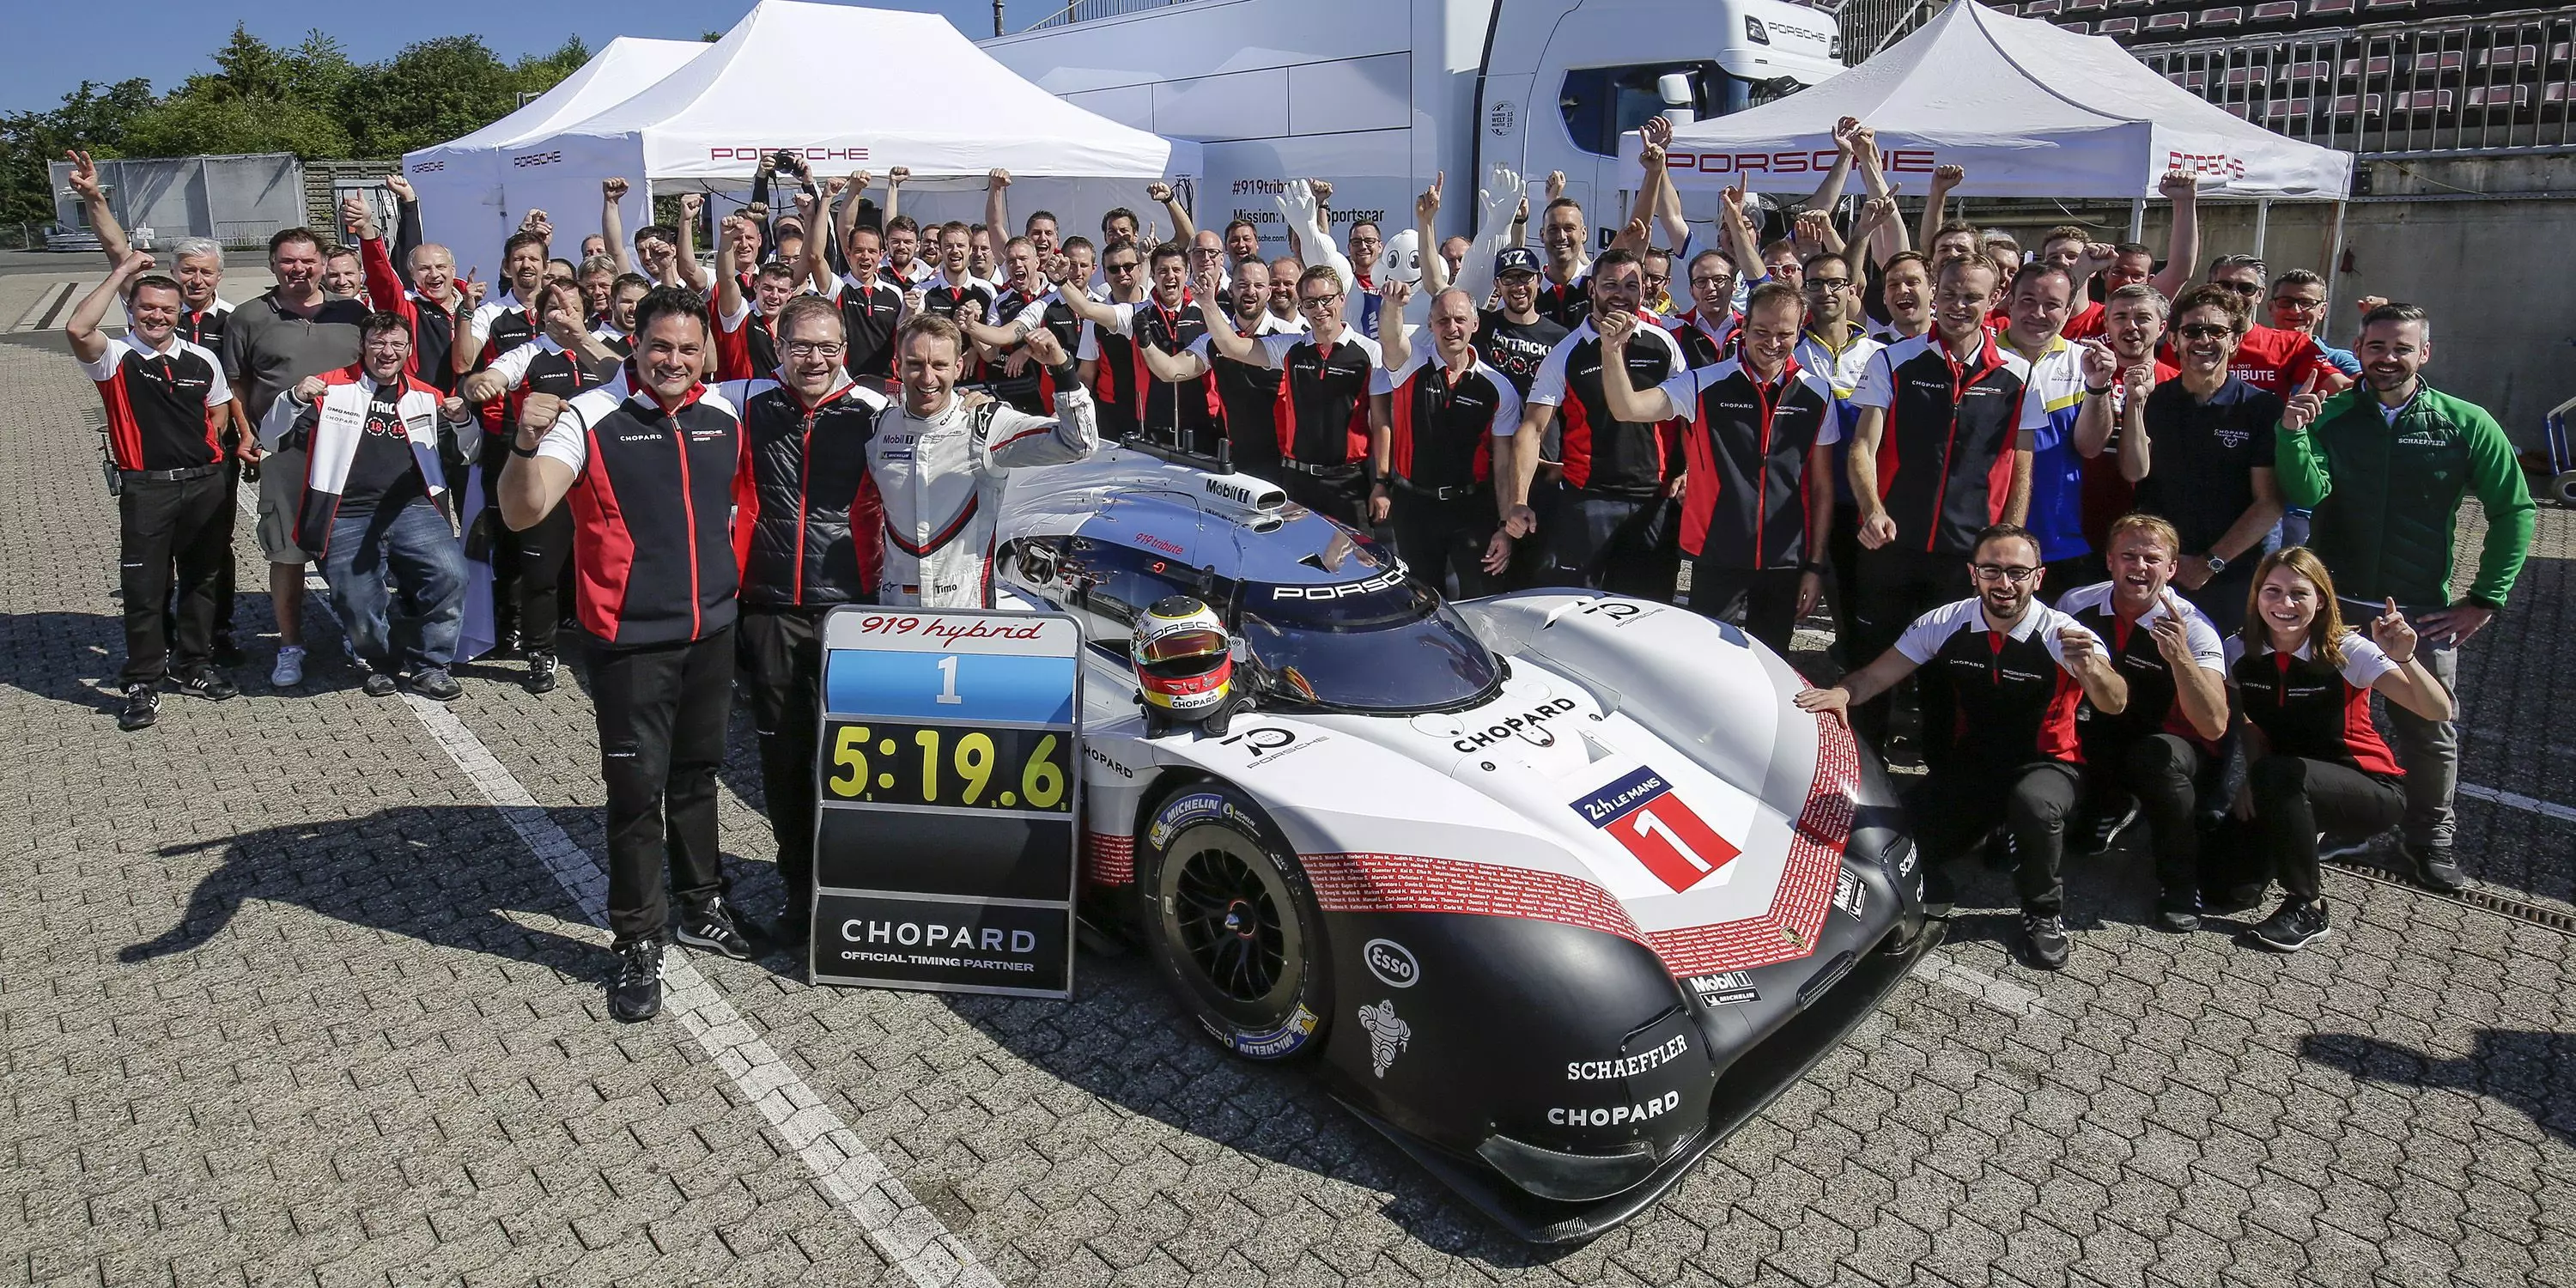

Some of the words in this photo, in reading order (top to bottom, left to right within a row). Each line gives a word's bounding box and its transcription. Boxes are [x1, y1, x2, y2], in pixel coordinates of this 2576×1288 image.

[1769, 21, 1826, 43] PORSCHE
[411, 161, 444, 173] PORSCHE
[513, 151, 561, 168] PORSCHE
[2168, 151, 2245, 179] PORSCHE
[1231, 179, 1289, 195] #919trib
[1233, 209, 1279, 223] Mission:
[325, 414, 358, 425] CHOPARD
[370, 422, 381, 432] 18
[883, 434, 904, 444] Mobil
[2397, 437, 2445, 447] SCHAEFFLER
[1206, 478, 1238, 501] Mobil
[1134, 532, 1154, 544] 919
[1151, 538, 1183, 555] tribute
[935, 583, 957, 594] Timo
[1273, 556, 1410, 600] PORSCHE
[861, 616, 920, 634] 919
[920, 617, 1046, 648] hybrid
[1141, 622, 1228, 648] PORSCHE
[1950, 659, 1984, 668] CHOPARD
[2002, 669, 2042, 679] PORSCHE
[936, 655, 963, 704] 1
[1172, 695, 1218, 708] CHOPARD
[1453, 697, 1577, 754] CHOPARD
[1219, 727, 1296, 756] 70
[1247, 736, 1331, 769] PORSCHE
[829, 726, 1064, 808] 5:19.6
[1083, 744, 1133, 779] HOPARD
[1612, 793, 1630, 808] LE
[1629, 777, 1661, 801] MANS
[1166, 799, 1218, 823] MICHELIN
[1631, 809, 1713, 874] 1
[1832, 877, 1854, 911] Mobil
[841, 919, 1036, 954] CHOPARD
[841, 951, 907, 963] OFFICIAL
[908, 955, 961, 968] TIMING
[963, 959, 1035, 972] PARTNER
[1689, 973, 1738, 993] Mobil
[1719, 992, 1755, 1002] MICHELIN
[1239, 1033, 1295, 1055] MICHELIN
[1567, 1034, 1688, 1081] SCHAEFFLER
[1547, 1091, 1680, 1127] CHOPARD
